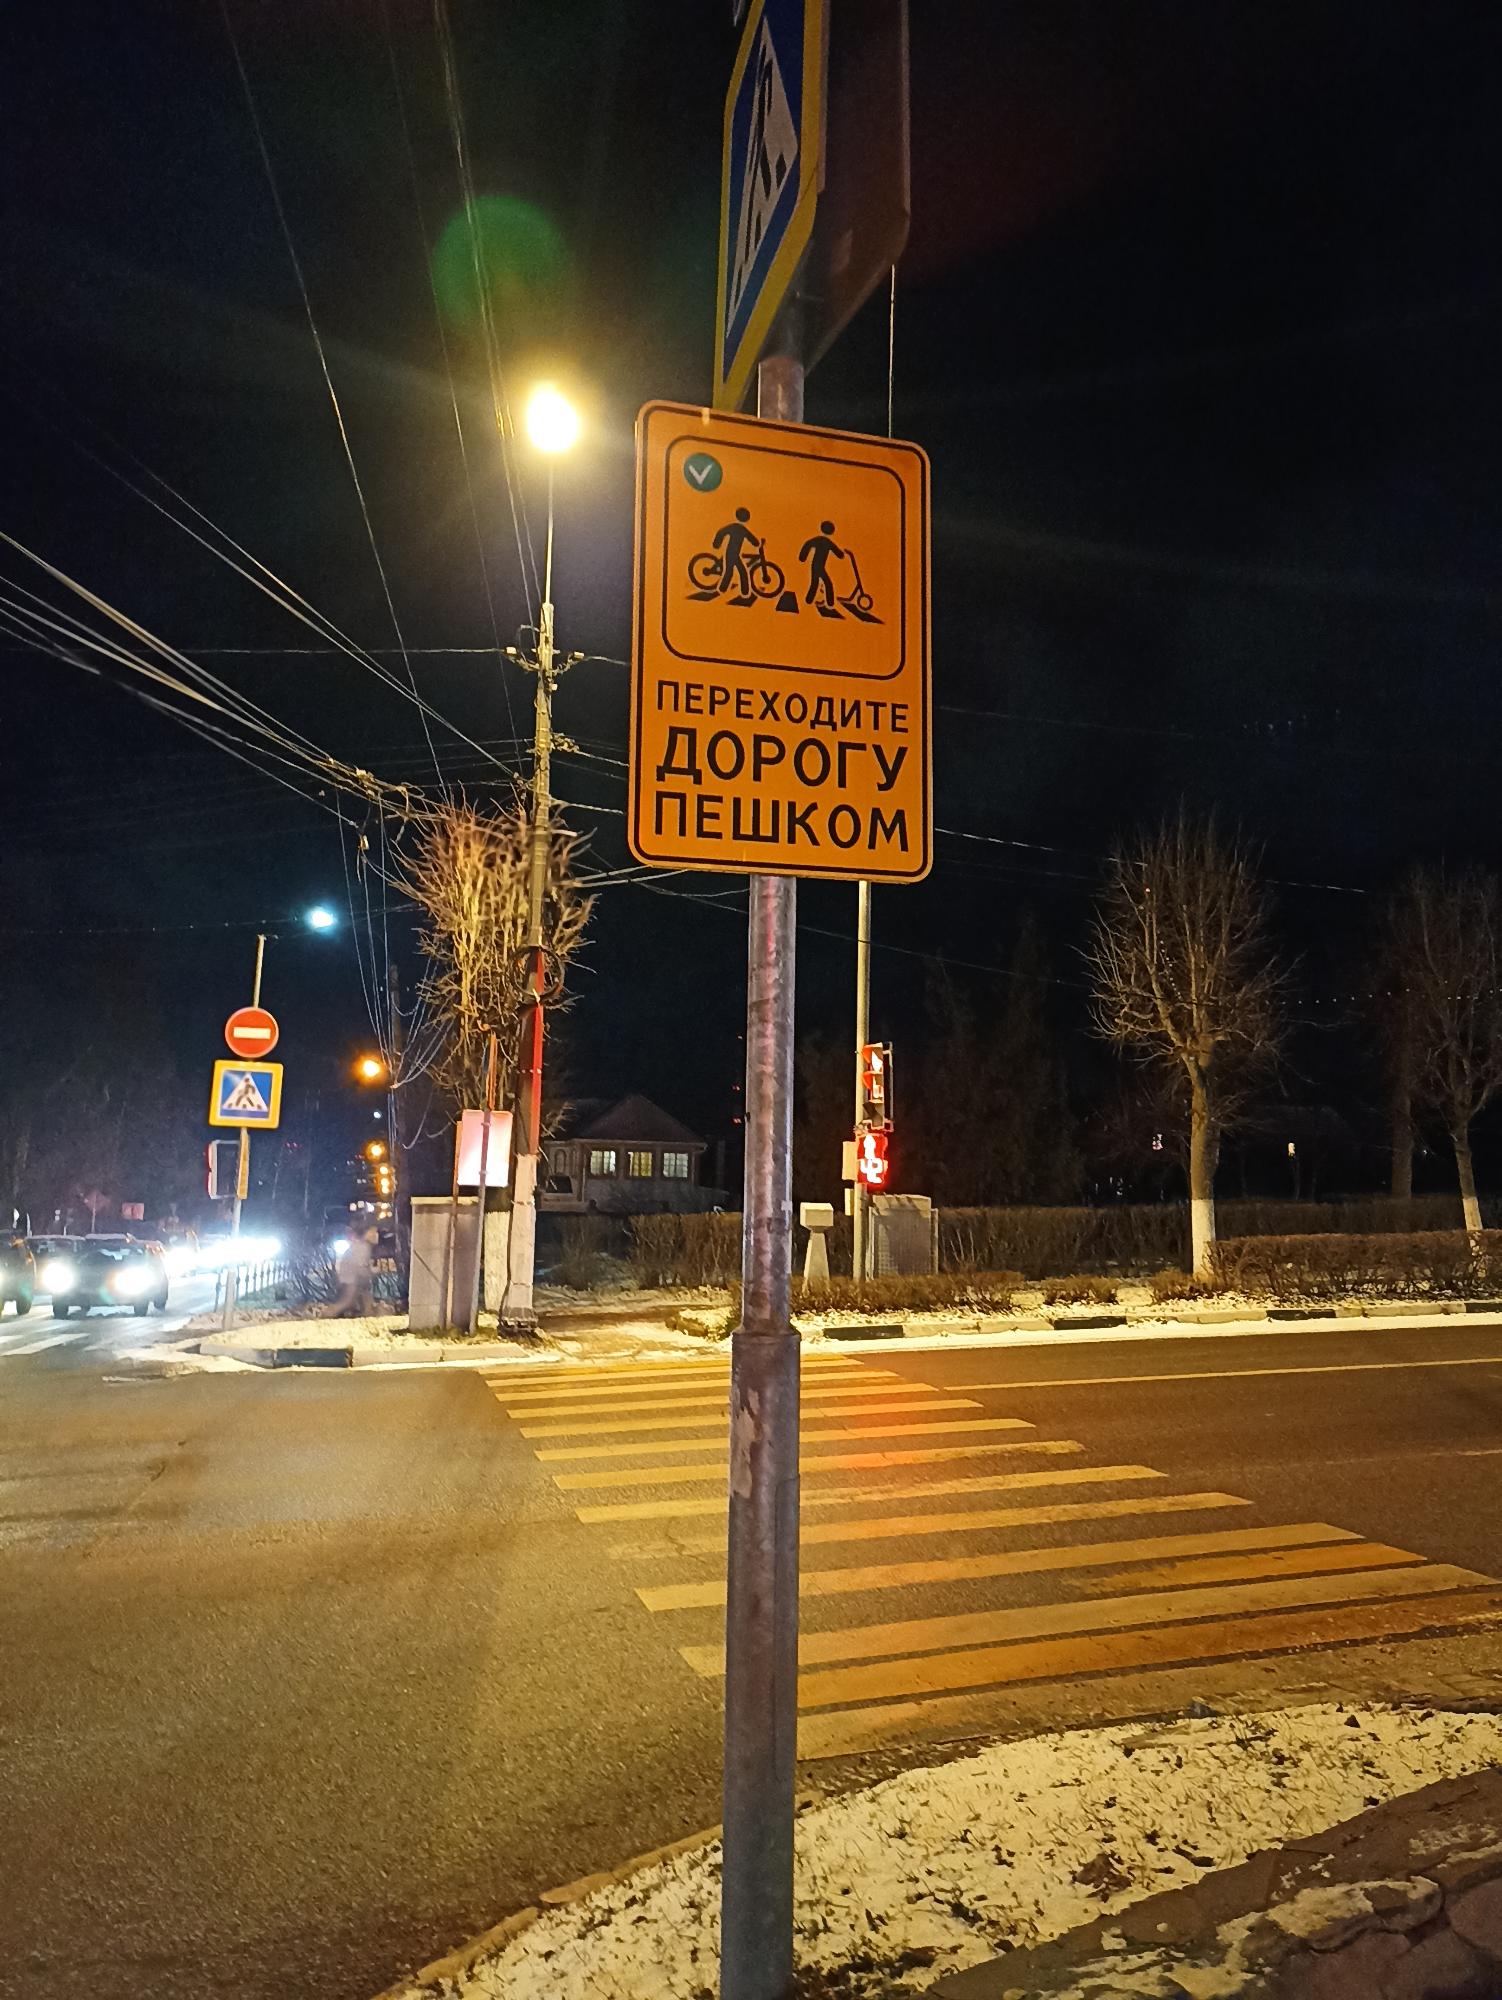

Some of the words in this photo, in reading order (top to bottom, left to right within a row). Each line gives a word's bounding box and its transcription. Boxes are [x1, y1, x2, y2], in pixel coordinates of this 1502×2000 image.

[657, 680, 909, 733] ПЕРЕХОДИТЕ
[656, 726, 908, 791] ДОРОГУ
[655, 790, 909, 852] ПЕШКОМ
